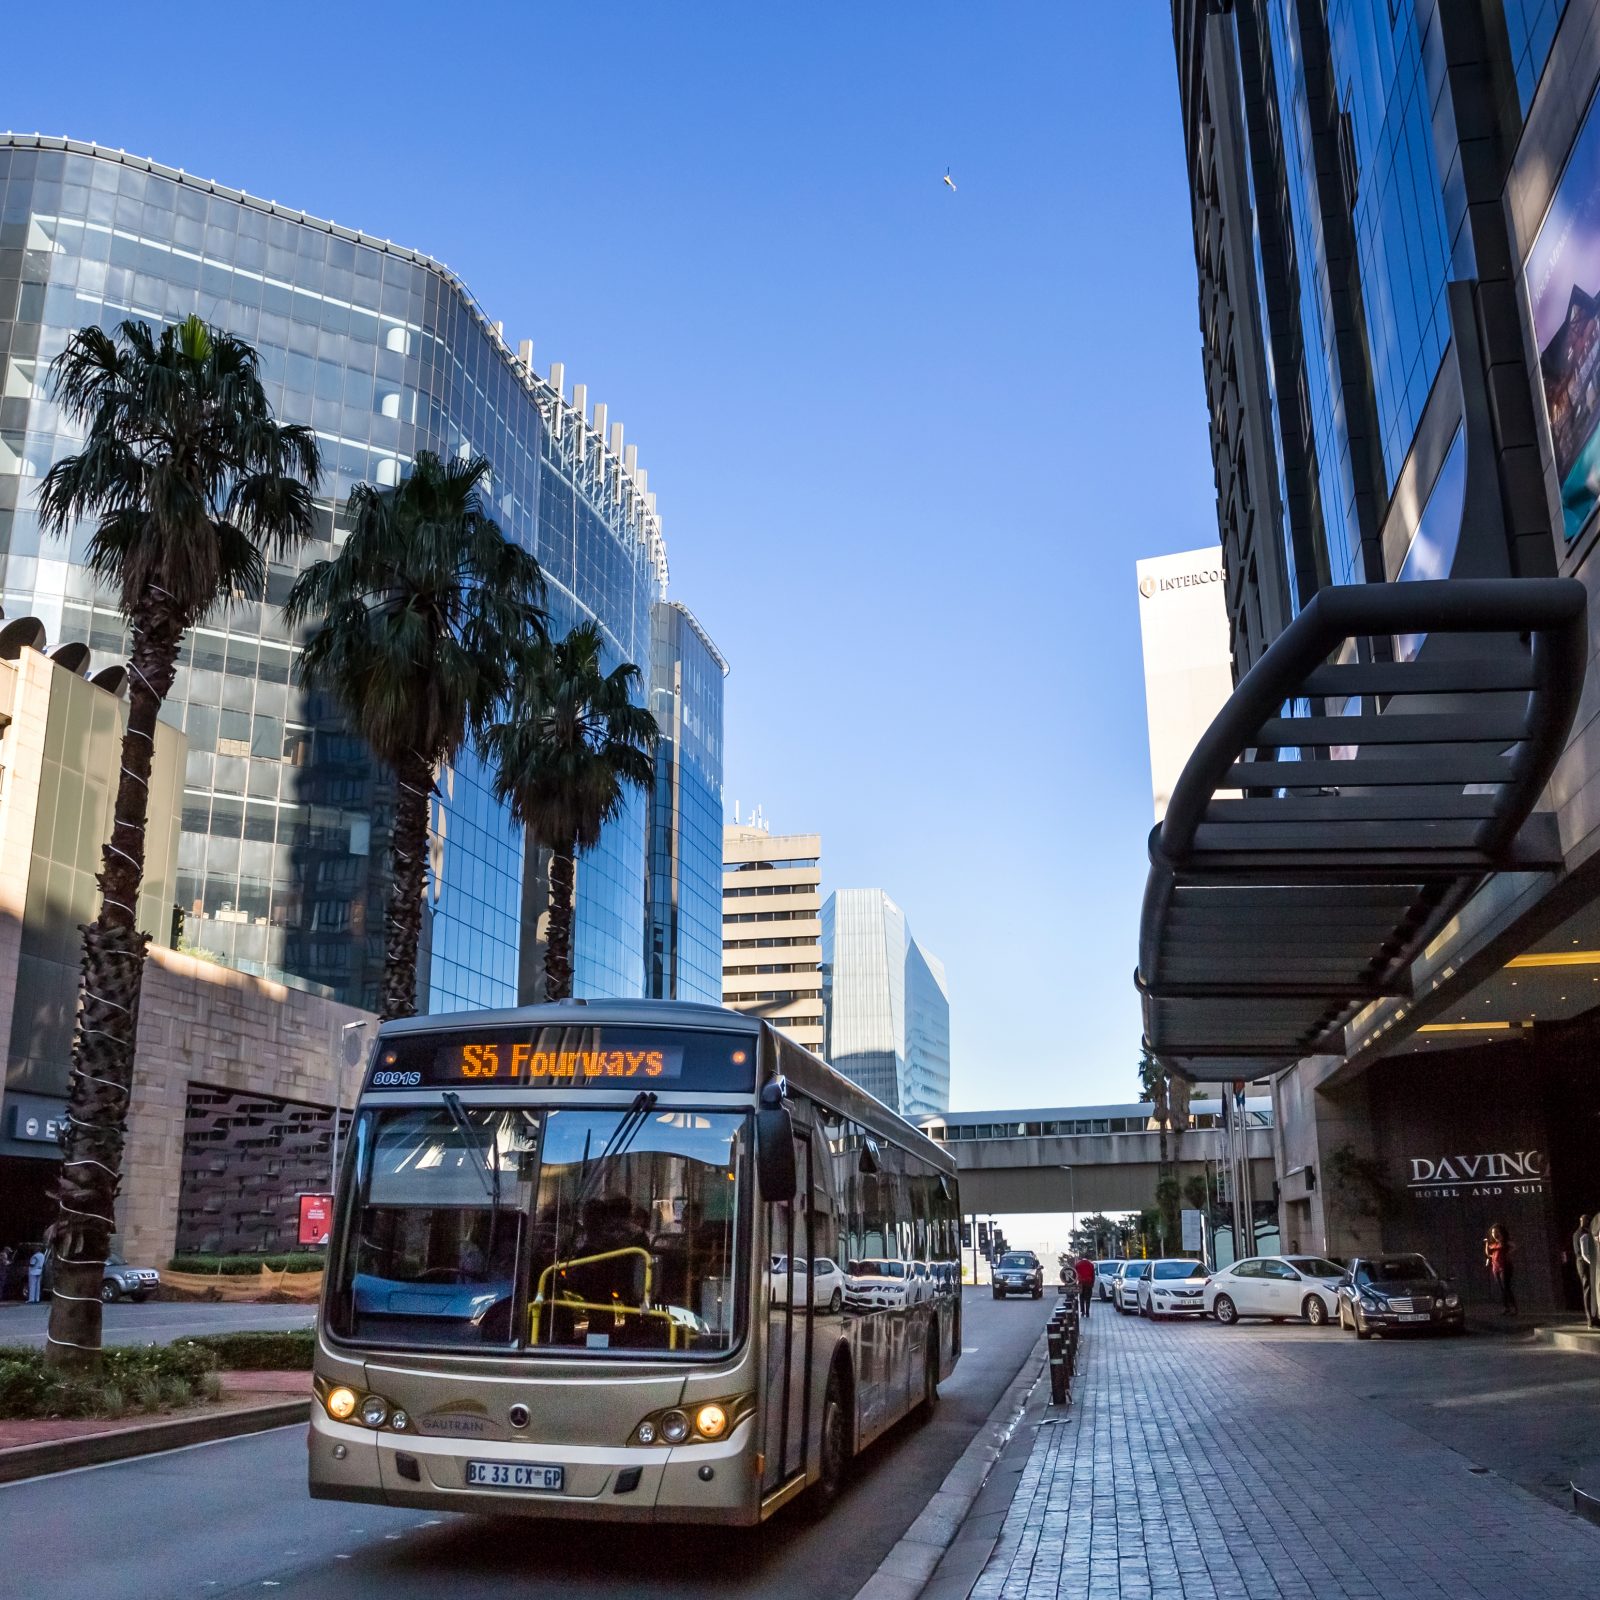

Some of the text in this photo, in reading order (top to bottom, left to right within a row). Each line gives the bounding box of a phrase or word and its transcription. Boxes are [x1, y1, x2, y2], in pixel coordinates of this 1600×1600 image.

[462, 1044, 664, 1077] S5 Fourways
[373, 1071, 421, 1085] 8091S
[1415, 1189, 1460, 1198] HOTEL
[1472, 1188, 1503, 1196] AND
[422, 1418, 485, 1432] GAUTRAIN
[469, 1464, 561, 1486] BC 33 CX GP
